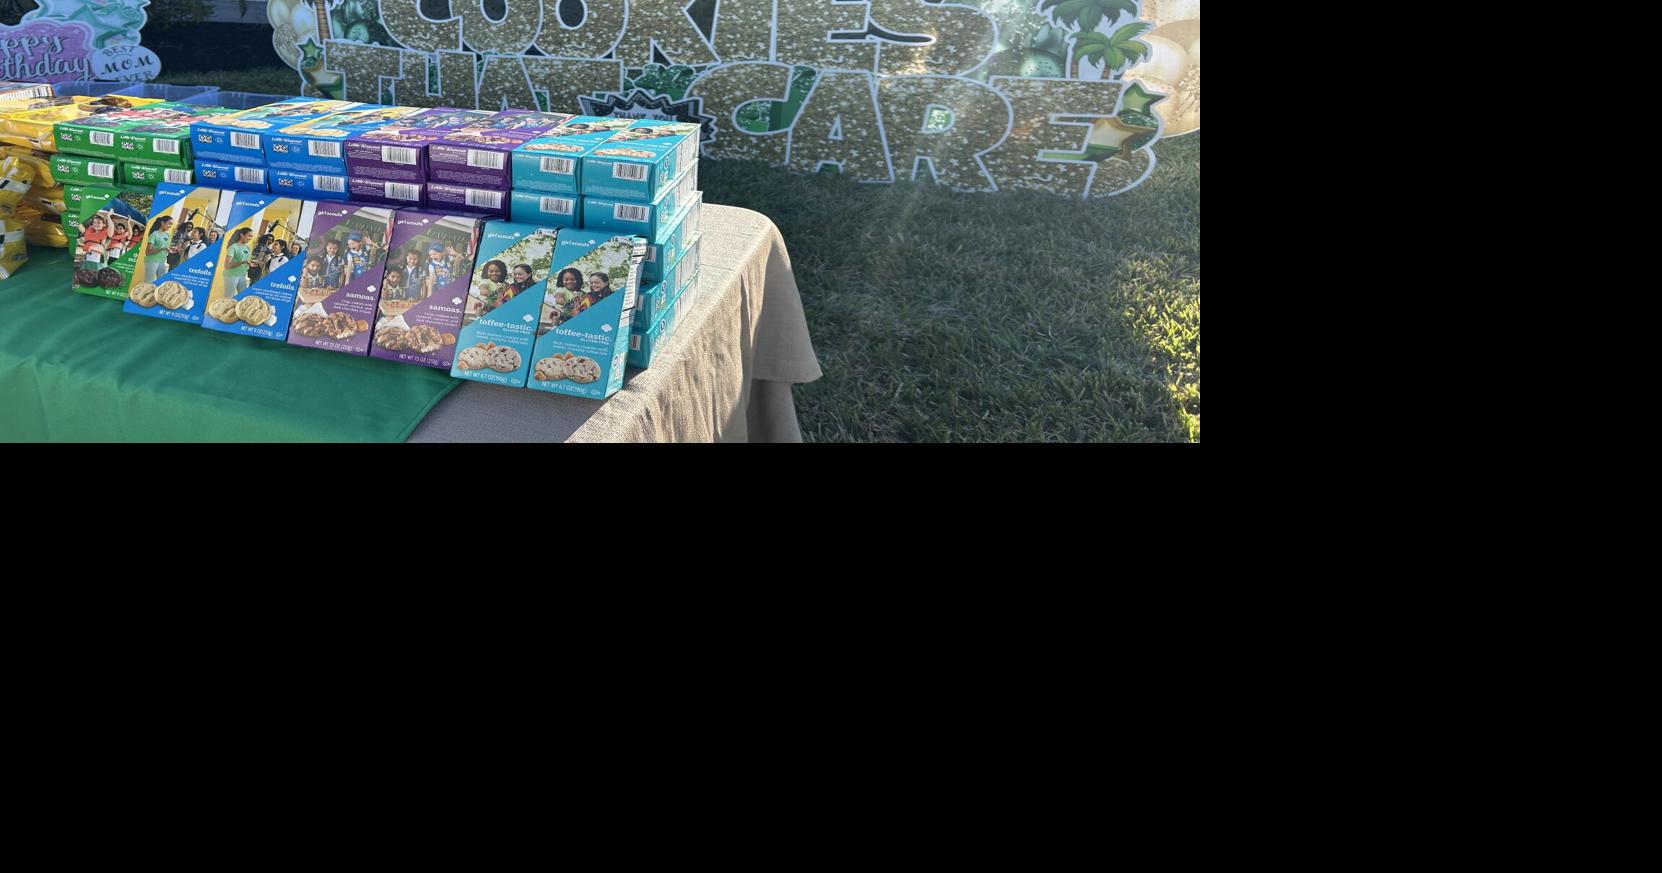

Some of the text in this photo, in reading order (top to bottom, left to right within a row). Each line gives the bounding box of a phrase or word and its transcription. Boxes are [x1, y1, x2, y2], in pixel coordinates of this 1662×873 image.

[0, 33, 67, 57] ppy
[104, 44, 135, 57] BEST
[0, 52, 96, 82] thday
[101, 54, 154, 75] MOM
[114, 70, 154, 82] VER
[683, 62, 1164, 201] CARE
[271, 282, 295, 291] trefoils
[346, 292, 375, 301] samoas
[429, 304, 461, 314] samoas
[479, 319, 533, 331] toffee-tastic
[555, 328, 612, 341] toffee-tastic
